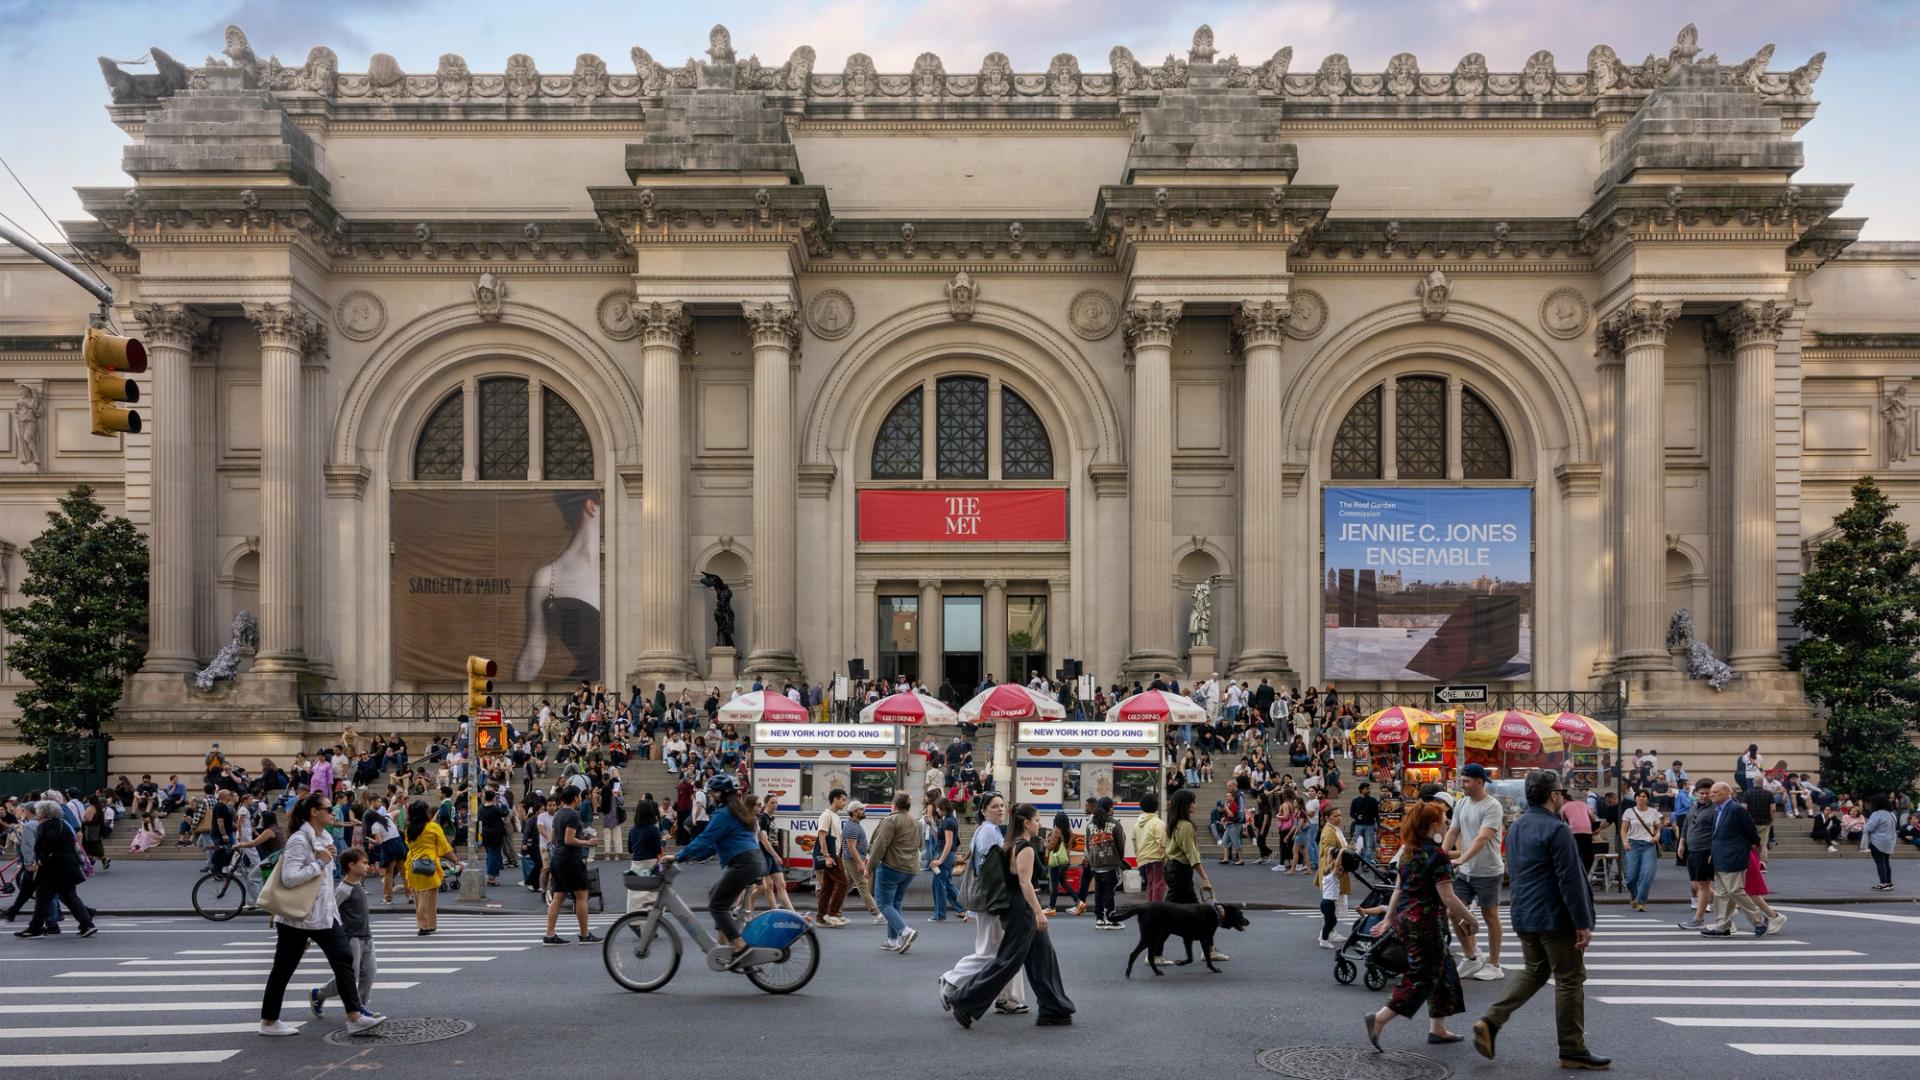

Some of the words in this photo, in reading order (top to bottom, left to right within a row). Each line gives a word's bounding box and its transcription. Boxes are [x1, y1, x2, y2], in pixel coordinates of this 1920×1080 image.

[945, 497, 980, 515] THE
[1353, 501, 1370, 509] Roof
[945, 516, 981, 535] MET
[1339, 523, 1415, 542] JENNIE
[1419, 524, 1441, 542] C.
[1444, 524, 1517, 542] JONES
[1366, 547, 1490, 565] ENSEMBLE
[408, 576, 462, 594] SARGENT
[463, 577, 474, 594] &
[476, 578, 511, 594] PARIS
[1442, 690, 1457, 698] ONE
[1464, 690, 1480, 698] WAY
[770, 729, 790, 737] NEW
[792, 729, 815, 738] YORK
[817, 730, 835, 738] HOT
[837, 730, 856, 738] DOG
[858, 730, 880, 738] KING
[1034, 728, 1054, 736] NEW
[1055, 729, 1079, 737] YORK
[1081, 729, 1099, 737] HOT
[1100, 729, 1120, 737] DOG
[1121, 729, 1143, 737] KING
[790, 820, 819, 831] NEW
